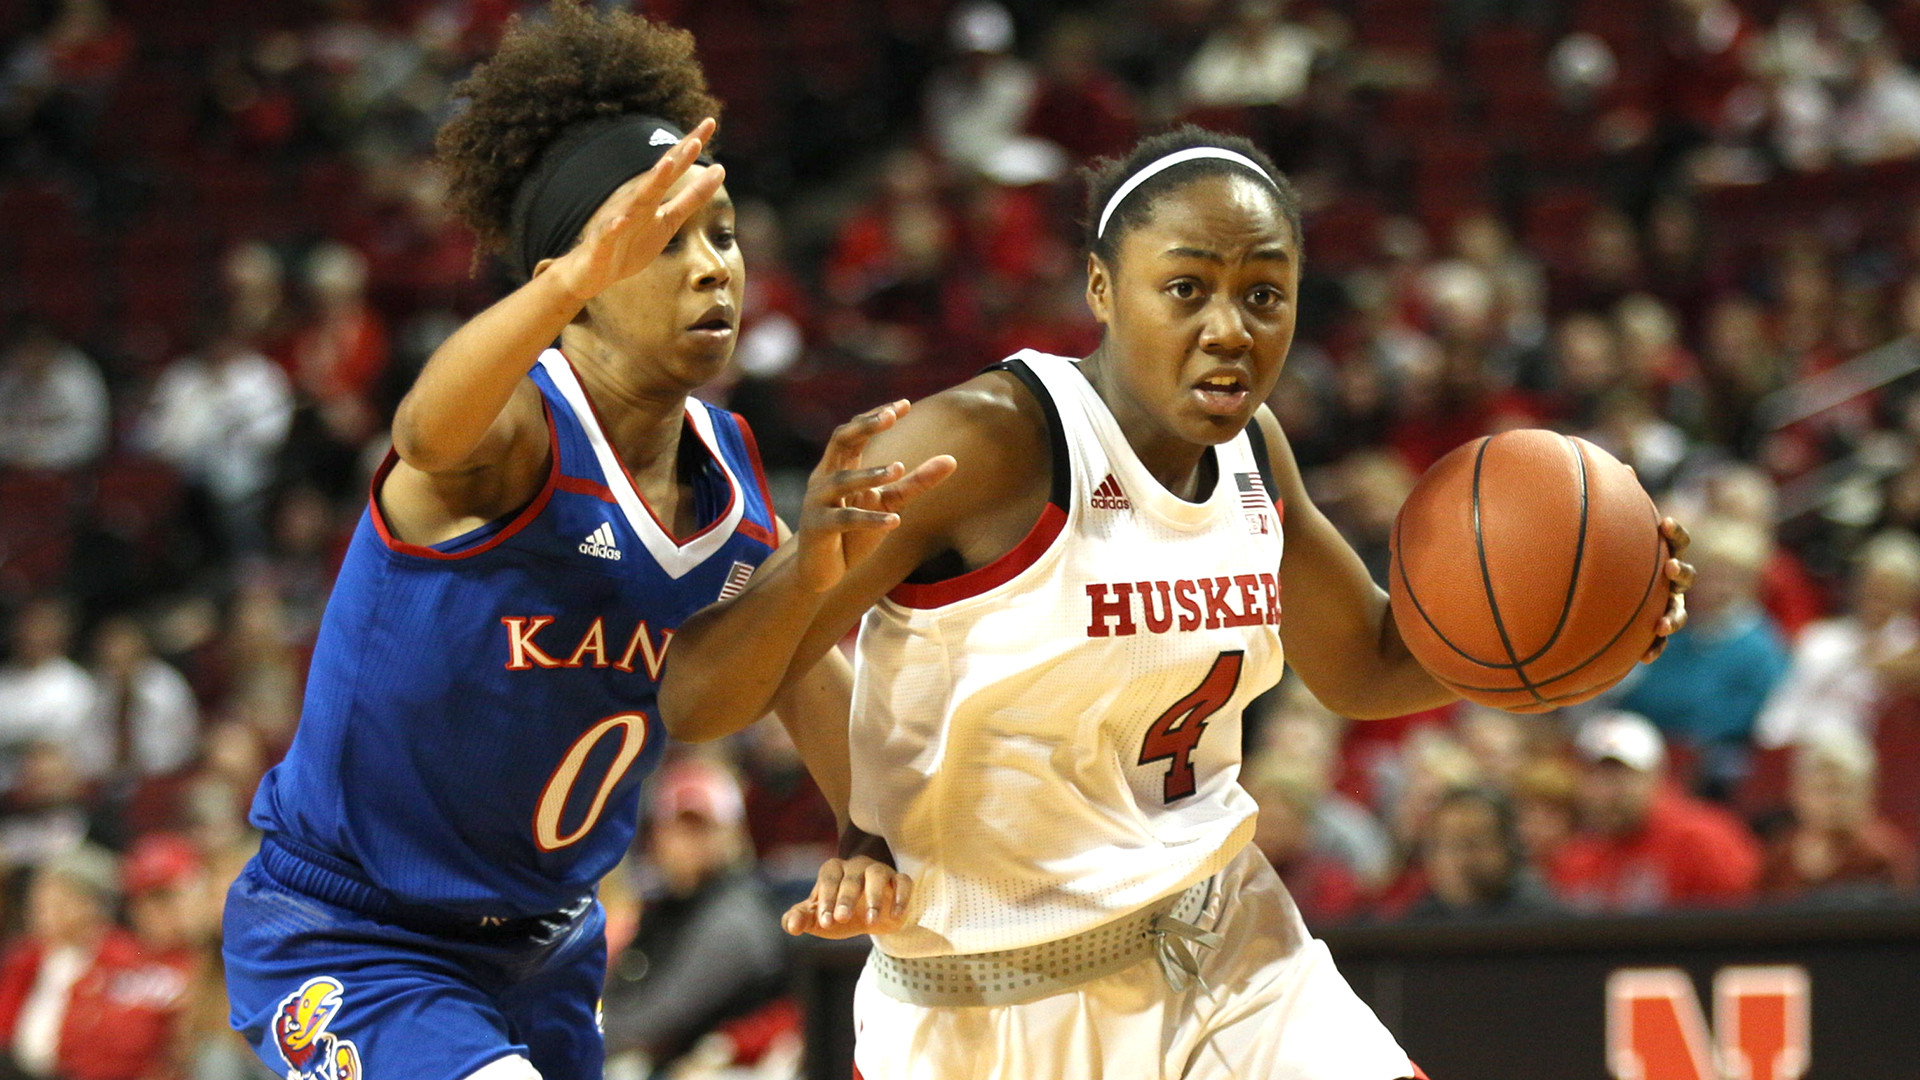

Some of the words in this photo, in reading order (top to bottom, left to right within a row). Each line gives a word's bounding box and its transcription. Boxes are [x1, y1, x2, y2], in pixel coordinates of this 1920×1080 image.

[1090, 496, 1130, 510] adidas
[578, 542, 622, 561] adidas
[1086, 573, 1281, 637] HUSKER
[1137, 649, 1245, 805] 4
[533, 711, 648, 852] 0
[1606, 966, 1811, 1080] N
